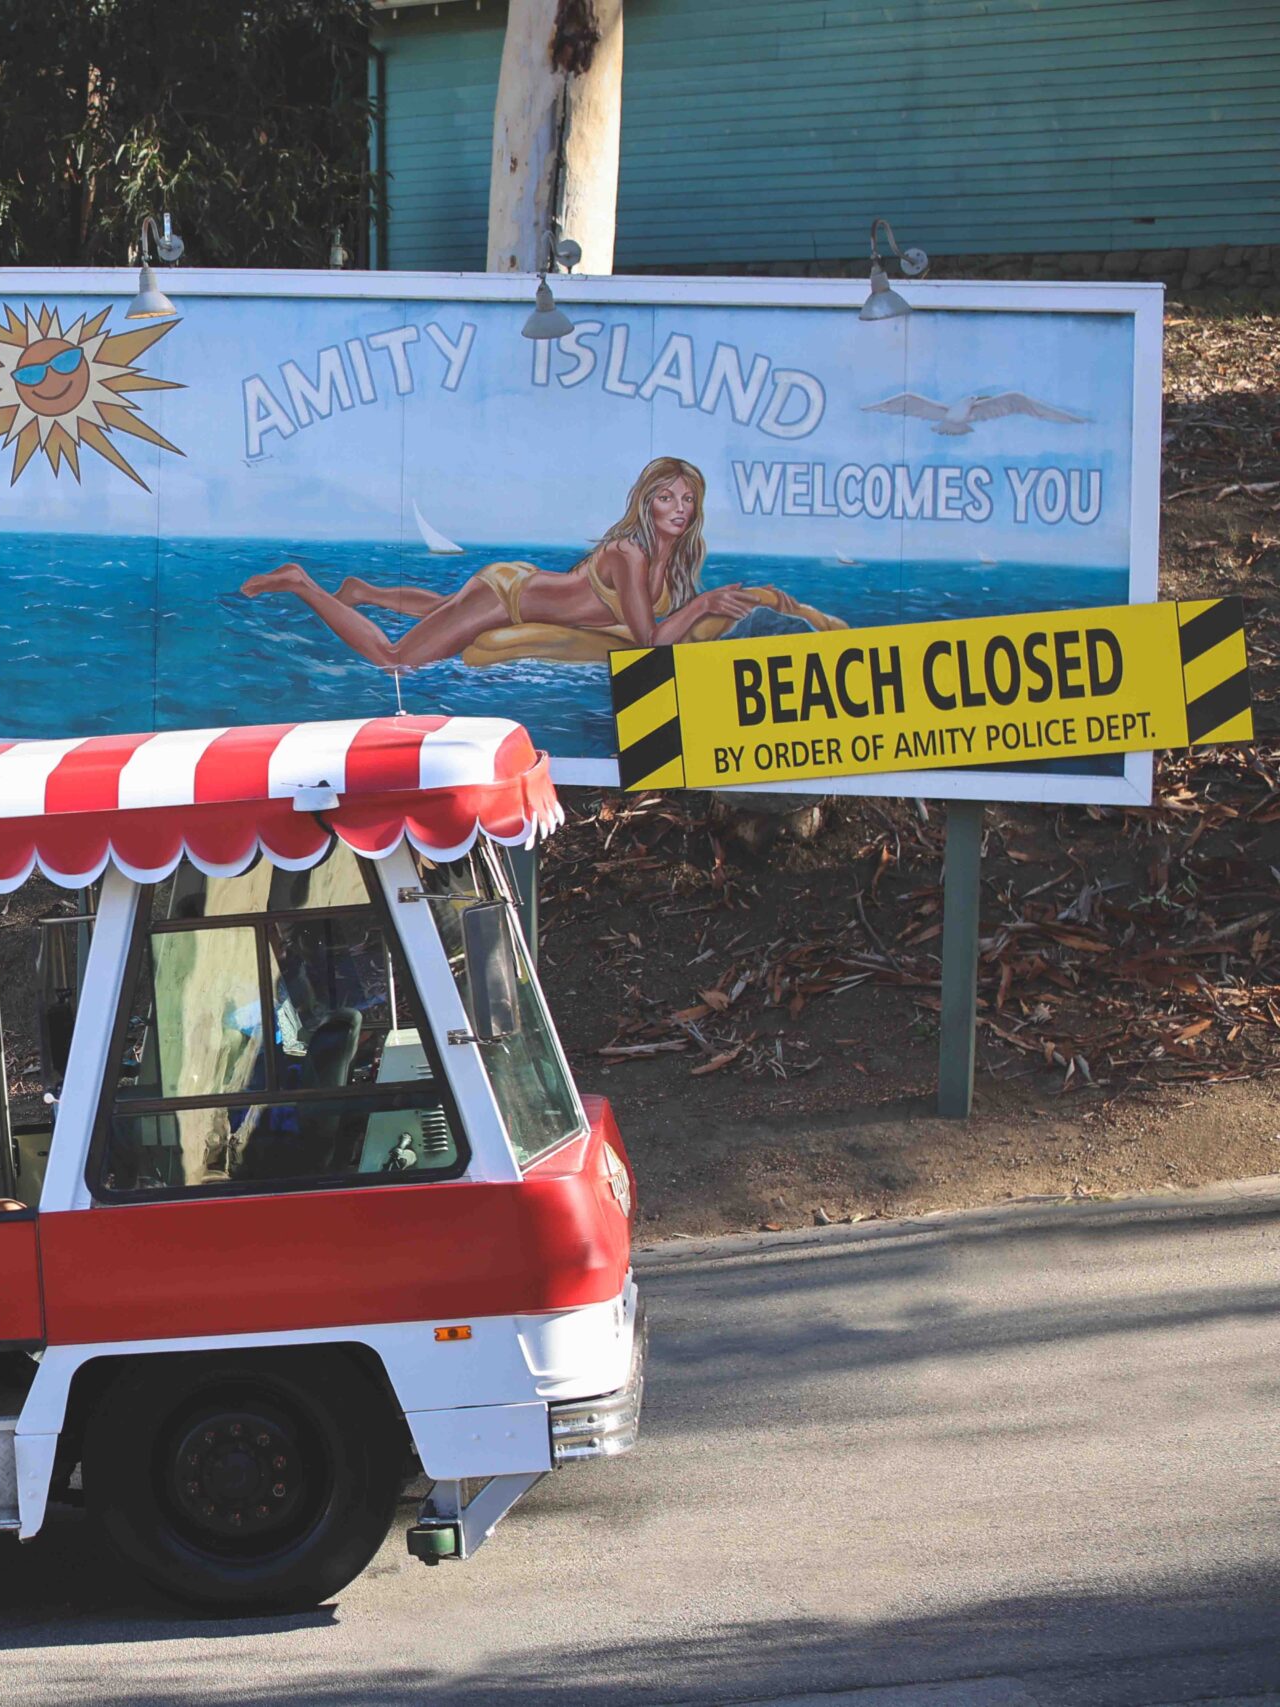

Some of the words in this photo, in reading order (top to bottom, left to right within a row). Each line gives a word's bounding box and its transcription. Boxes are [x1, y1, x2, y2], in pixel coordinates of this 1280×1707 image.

[241, 322, 477, 459] AMITY
[532, 320, 827, 440] ISLAND
[732, 461, 993, 522] WELCOMES
[1006, 464, 1102, 526] YOU
[733, 645, 907, 727] BEACH
[923, 628, 1124, 711] CLOSED
[714, 745, 744, 774] BY
[753, 738, 843, 768] ORDER
[851, 734, 885, 761] OF
[893, 726, 978, 758] AMITY
[985, 718, 1077, 751] POLICE
[1086, 711, 1157, 743] DEPT.
